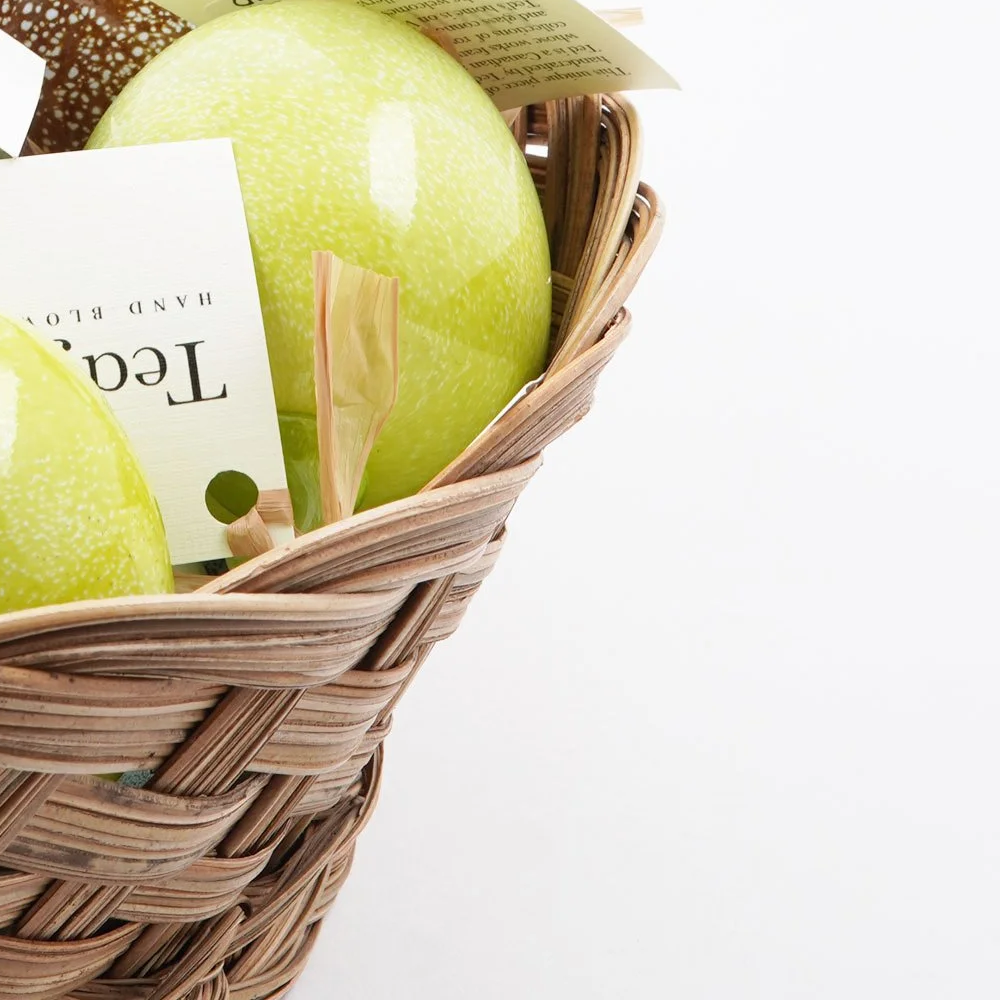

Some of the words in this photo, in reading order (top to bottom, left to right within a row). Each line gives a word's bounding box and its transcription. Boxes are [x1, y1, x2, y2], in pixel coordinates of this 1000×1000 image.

[456, 4, 500, 18] home
[496, 0, 542, 12] Ted's
[416, 14, 439, 25] on
[480, 13, 517, 26] glass
[517, 10, 549, 22] and
[491, 21, 568, 37] collections
[474, 32, 492, 43] of
[531, 32, 580, 45] whose
[488, 39, 533, 53] works
[552, 47, 570, 57] is
[566, 44, 603, 56] Ted
[539, 48, 553, 57] a
[468, 51, 543, 70] Canadian
[521, 55, 613, 75] handcrafted
[502, 67, 525, 77] by
[544, 71, 593, 82] unique
[594, 66, 632, 77] This
[501, 76, 541, 90] piece
[128, 291, 213, 316] HAND
